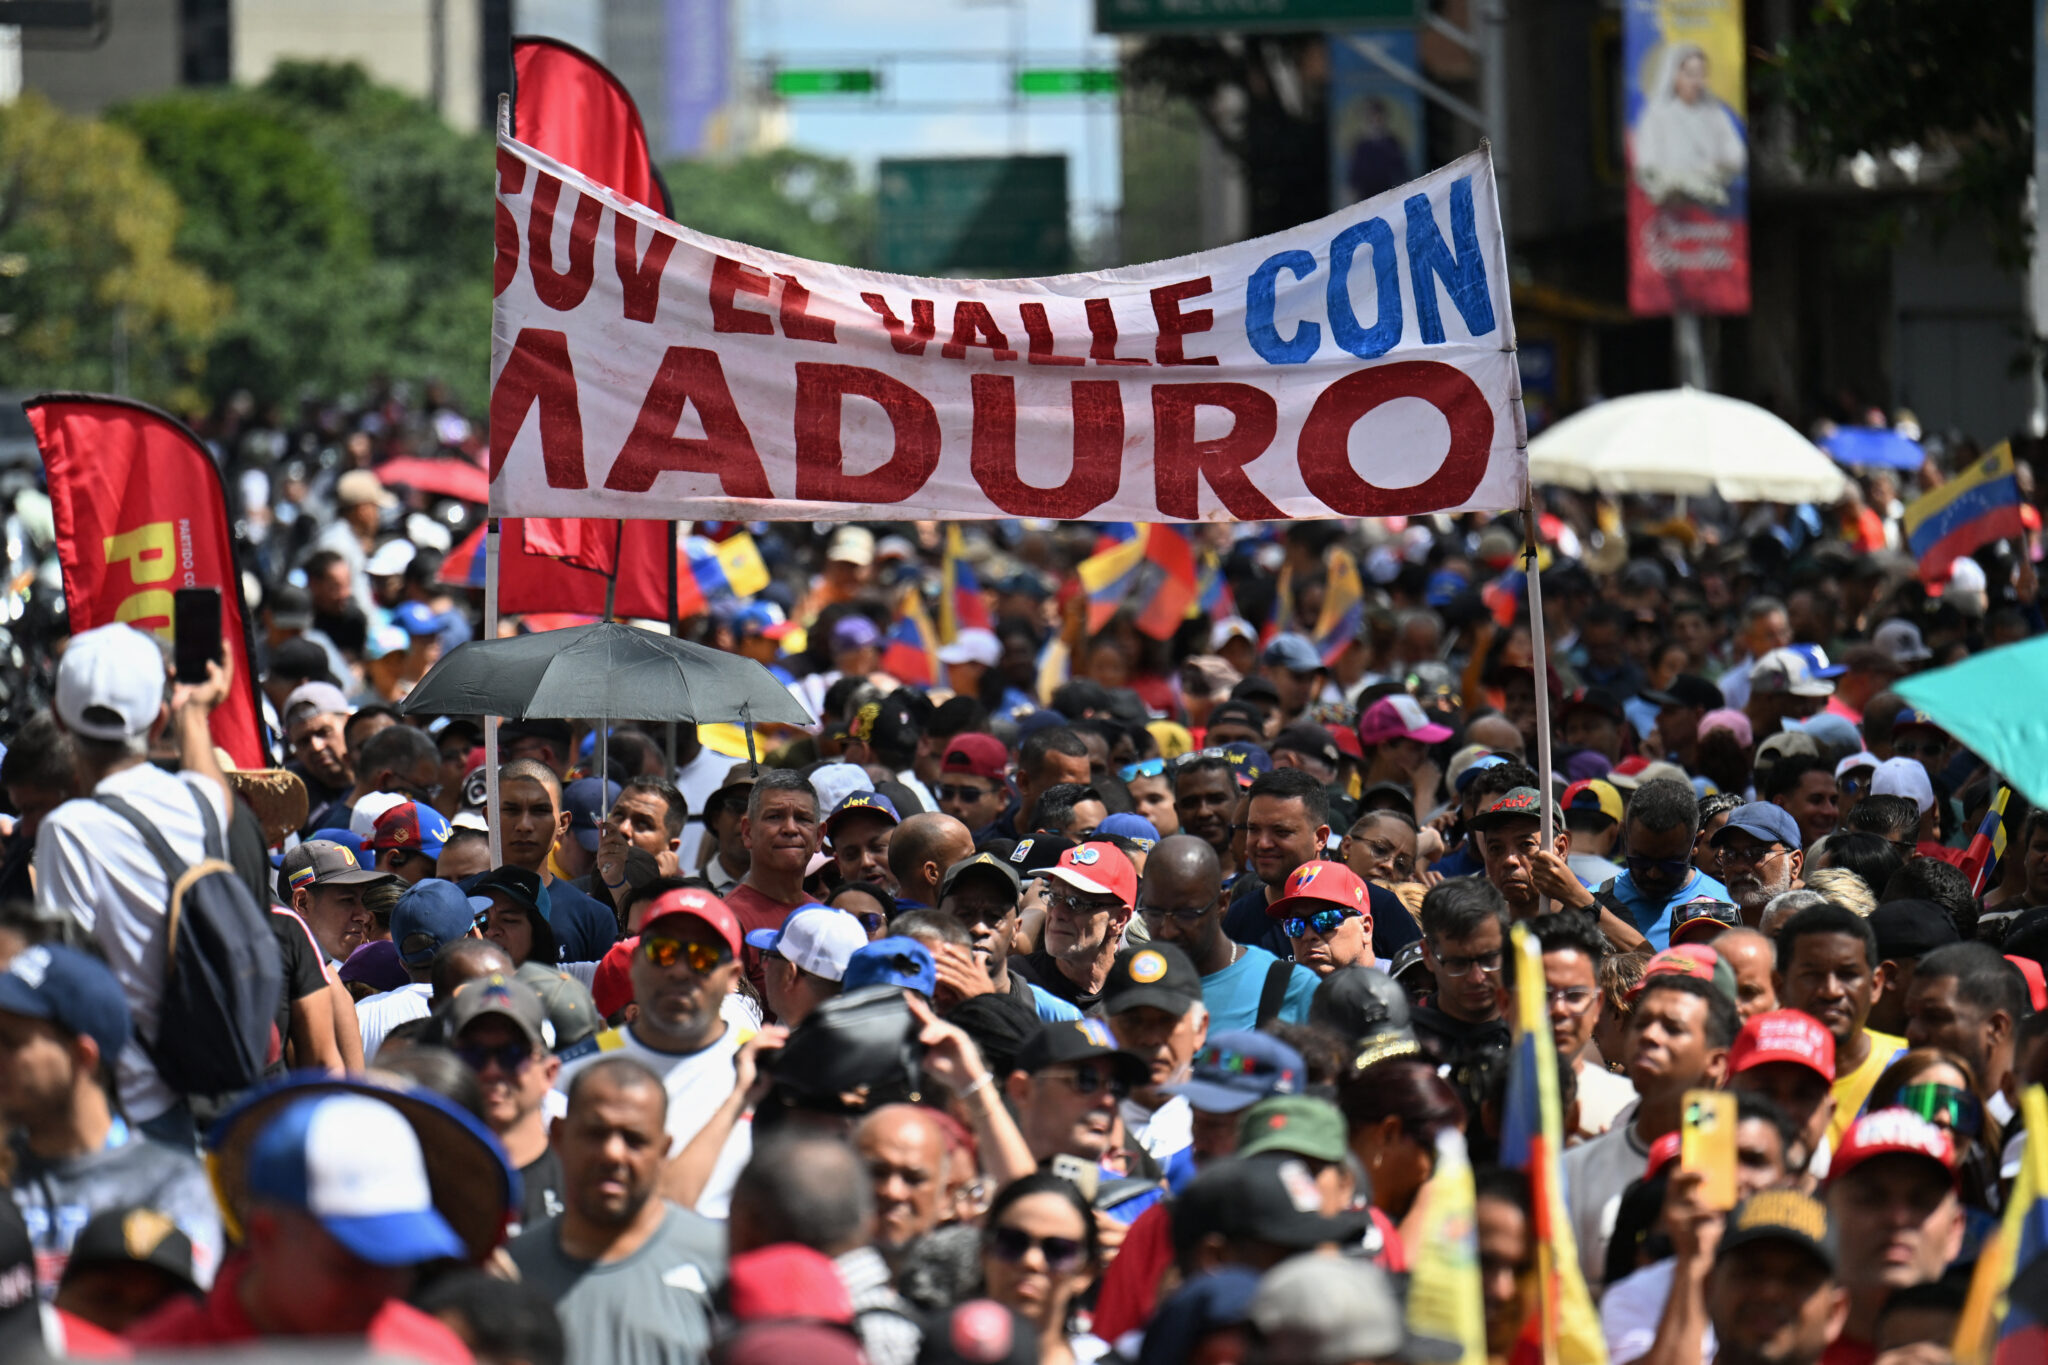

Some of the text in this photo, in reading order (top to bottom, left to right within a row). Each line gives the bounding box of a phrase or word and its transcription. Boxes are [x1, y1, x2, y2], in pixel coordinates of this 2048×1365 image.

[709, 254, 837, 343] EL
[860, 275, 1219, 366] VALLE
[1246, 175, 1495, 364] CON
[179, 518, 194, 569] PARTIDO
